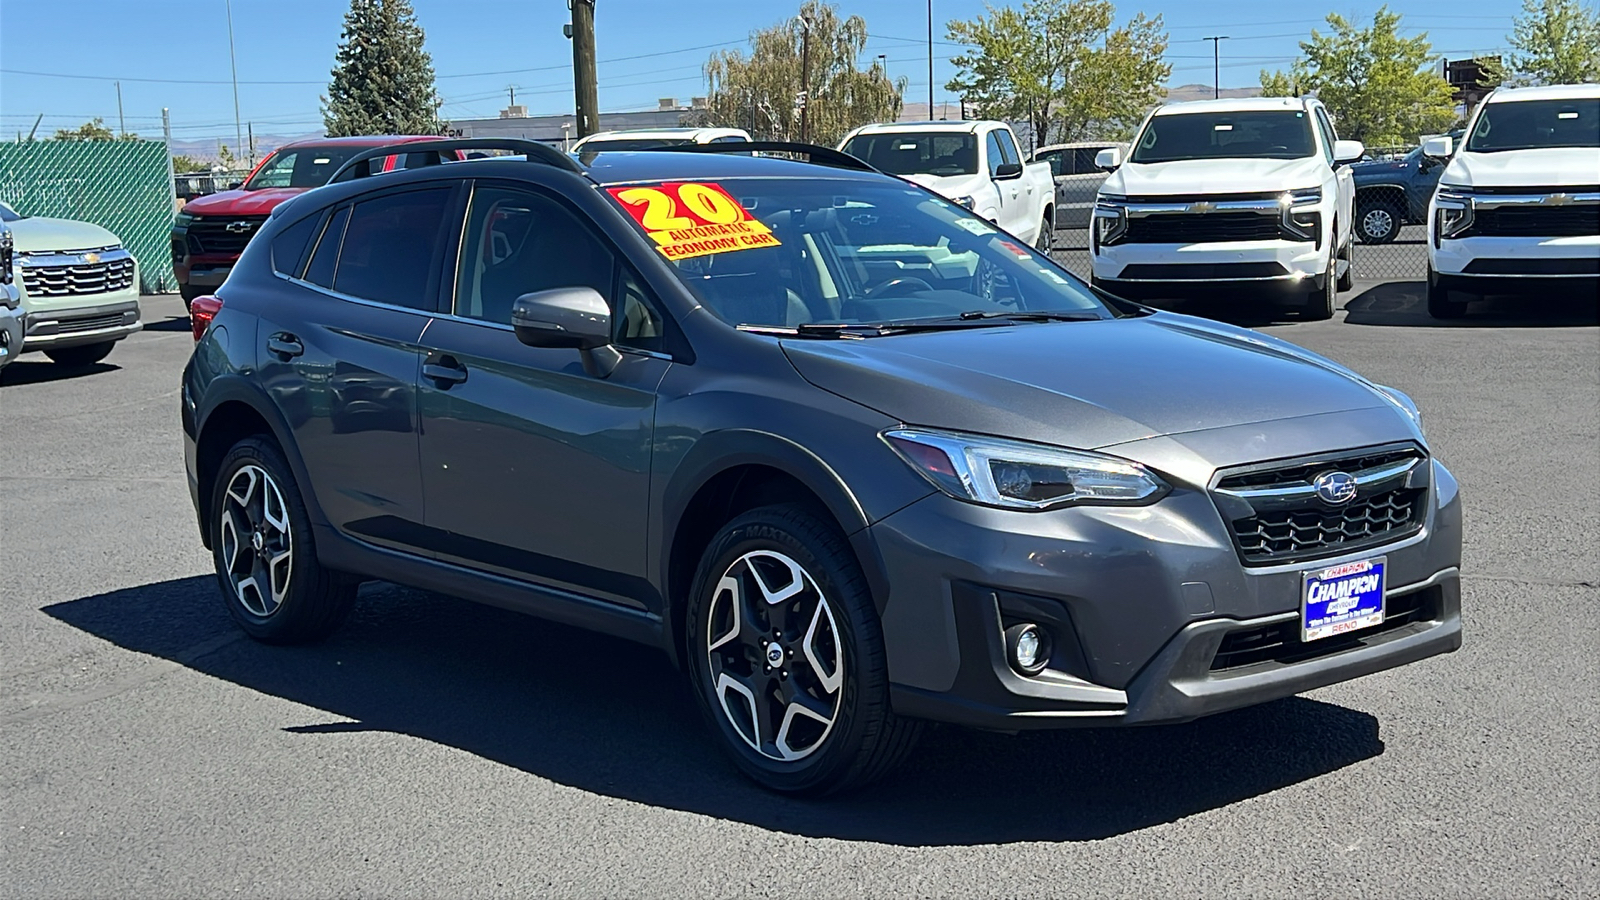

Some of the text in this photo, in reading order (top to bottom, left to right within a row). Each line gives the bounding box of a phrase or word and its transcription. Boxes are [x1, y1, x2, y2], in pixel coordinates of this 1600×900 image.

[617, 183, 744, 230] 20
[669, 221, 751, 242] AUTOMATIC
[663, 233, 773, 257] ECONOMY CAR
[1327, 563, 1366, 577] CHAMPION
[1308, 574, 1379, 604] CHAMPION
[1330, 600, 1356, 610] CHEVROLET
[1332, 620, 1357, 633] RENO
